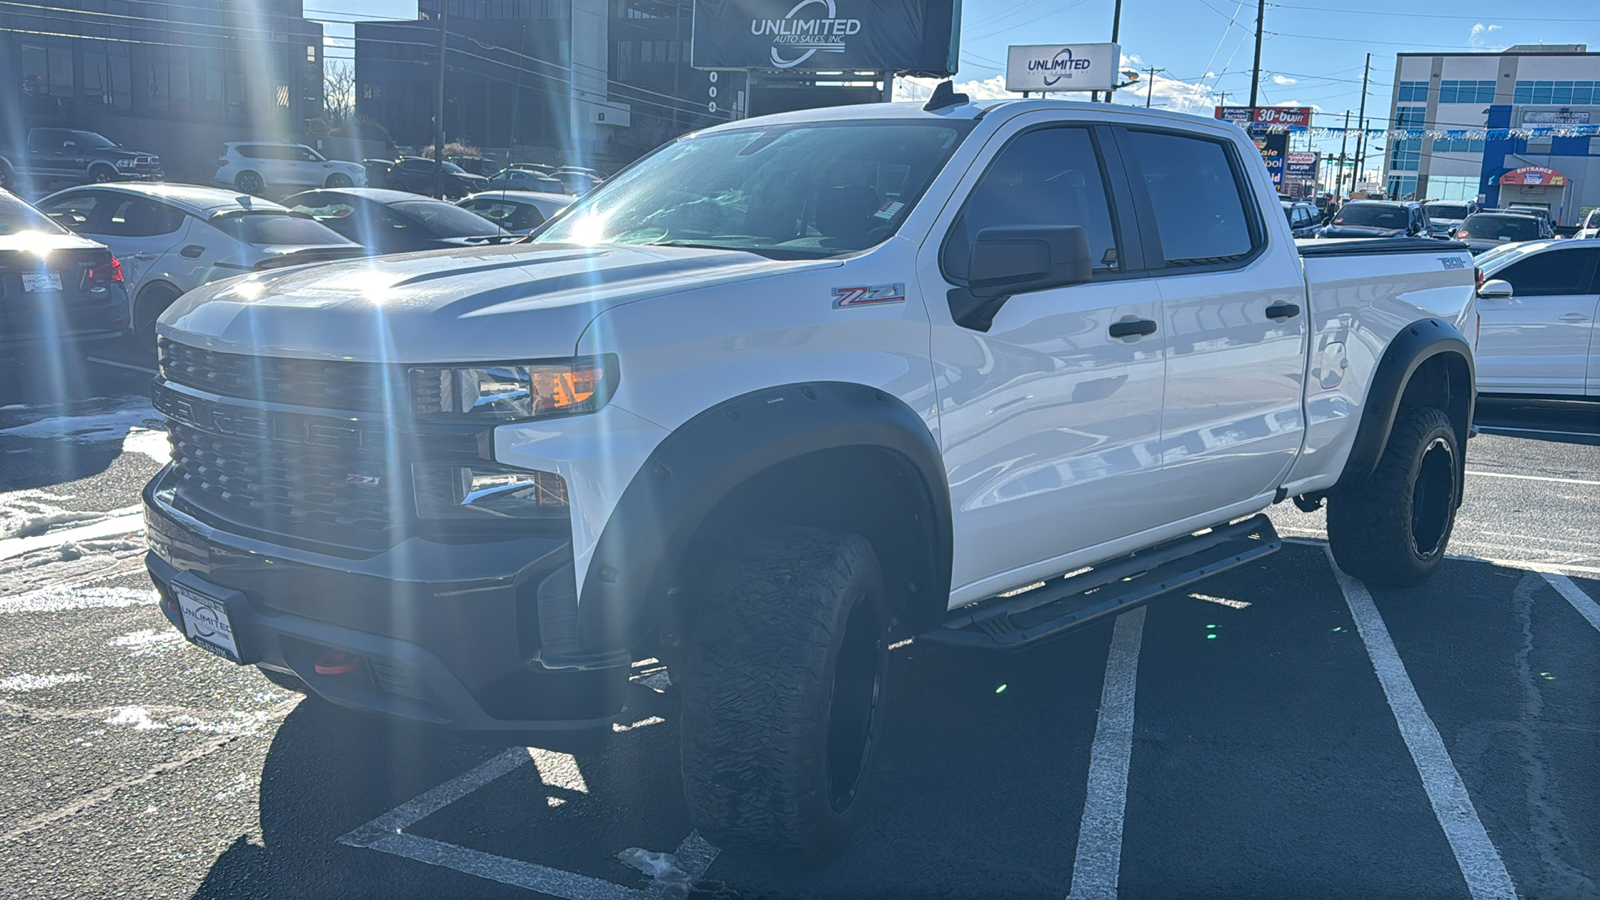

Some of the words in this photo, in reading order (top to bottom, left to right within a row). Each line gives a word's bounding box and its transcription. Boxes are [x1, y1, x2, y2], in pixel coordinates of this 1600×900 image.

[751, 19, 861, 35] UNLIMITED
[773, 35, 798, 43] AUTO
[799, 35, 826, 44] SALES,
[1027, 59, 1091, 71] UNLIMITED
[1517, 166, 1553, 175] ENTRANCE
[831, 282, 906, 310] Z71
[346, 473, 380, 487] Z71
[181, 605, 232, 633] UNLIMITED
